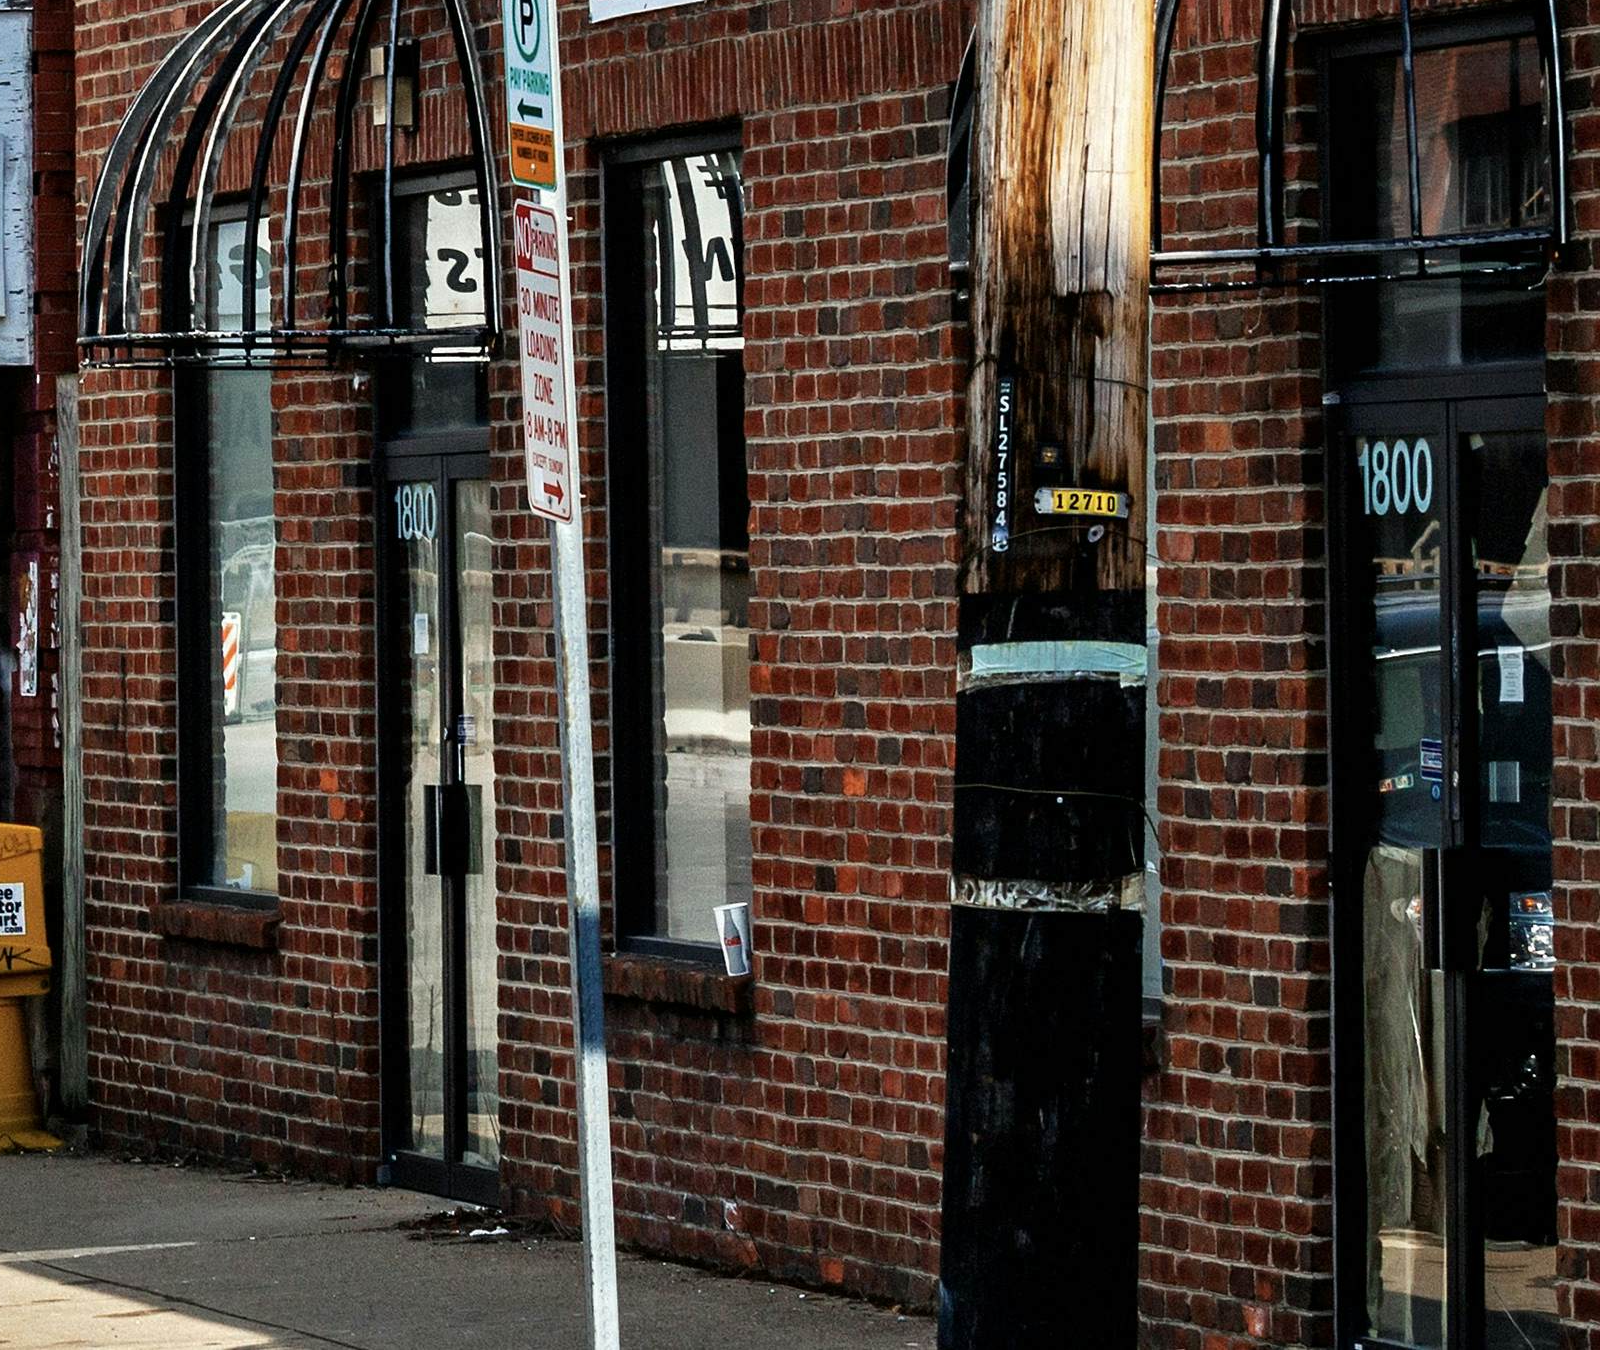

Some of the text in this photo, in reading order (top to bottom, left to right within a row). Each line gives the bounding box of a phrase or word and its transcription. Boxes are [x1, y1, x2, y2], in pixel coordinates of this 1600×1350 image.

[516, 215, 558, 261] NO PARKING
[521, 287, 560, 324] 30 MINUTE
[526, 329, 558, 365] LOADING
[533, 373, 554, 406] ZONE
[1357, 438, 1432, 517] 1800
[395, 485, 437, 540] 1800
[1055, 493, 1116, 513] 12710
